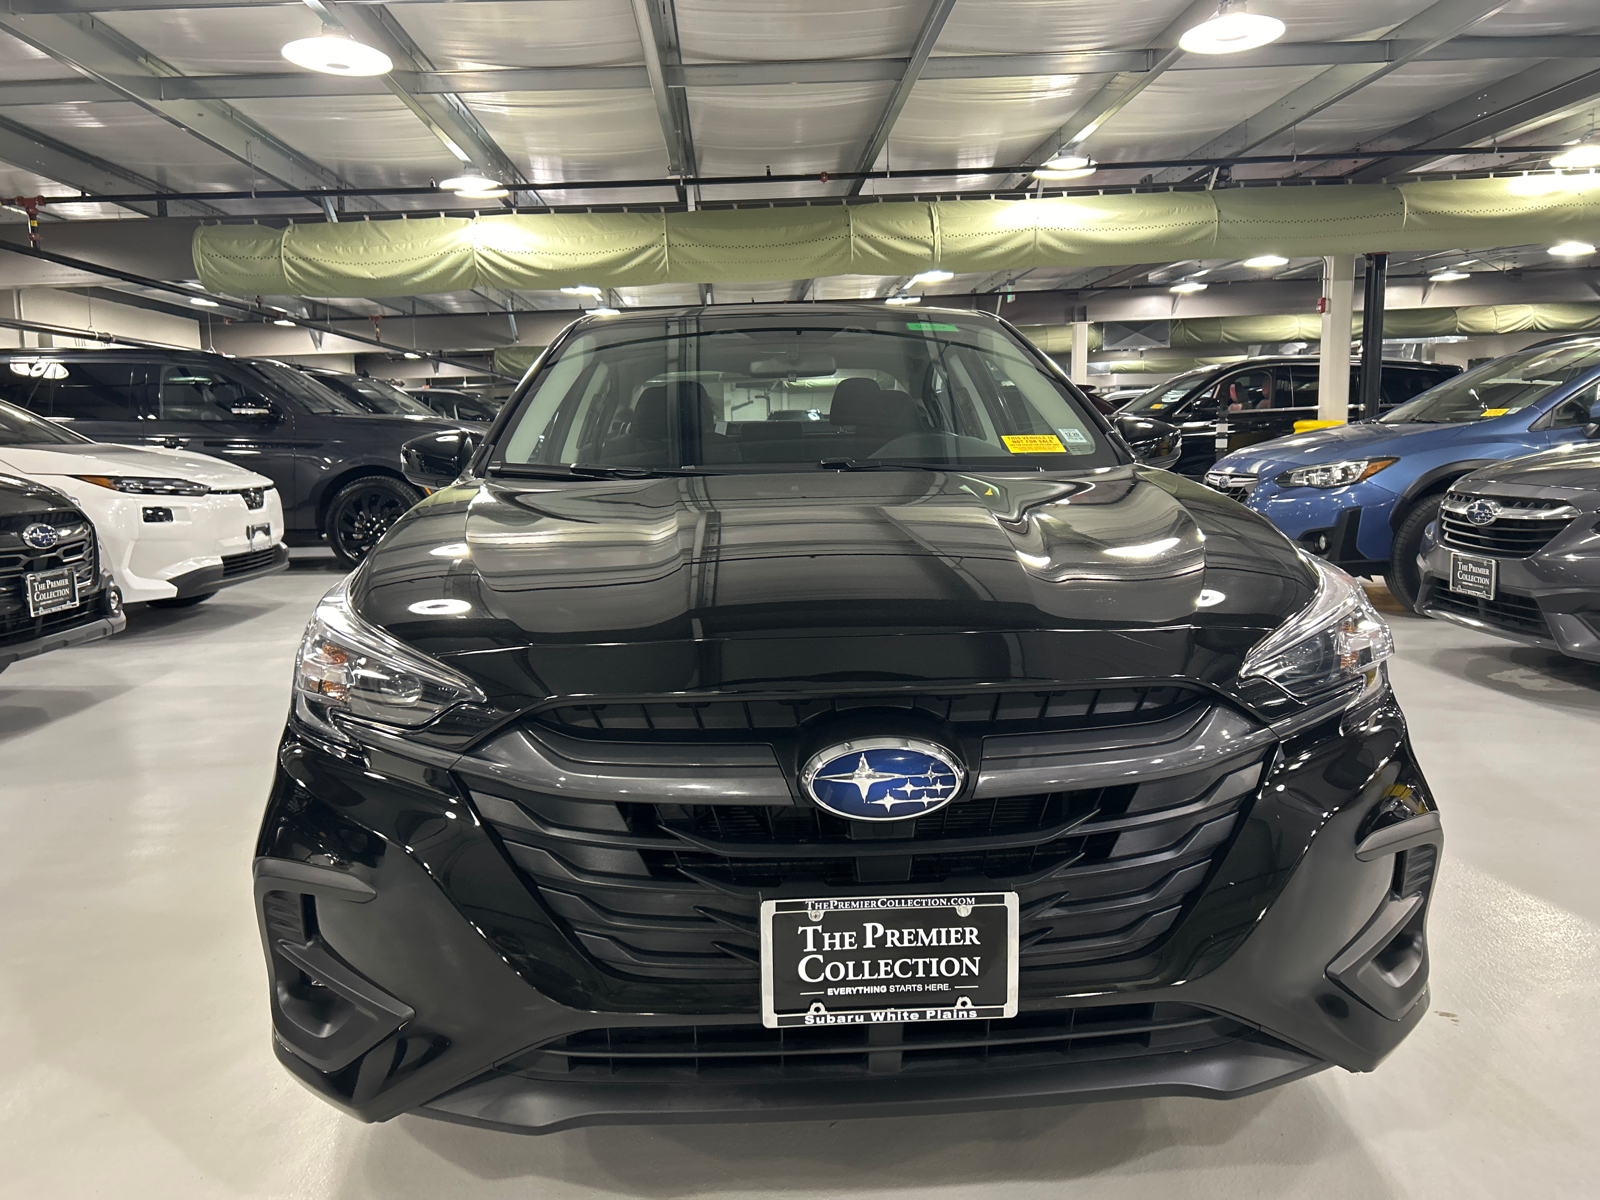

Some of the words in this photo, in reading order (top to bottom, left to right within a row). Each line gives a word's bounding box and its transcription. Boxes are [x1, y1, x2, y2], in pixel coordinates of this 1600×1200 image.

[798, 925, 858, 952] THE
[862, 922, 981, 949] PREMIER
[797, 954, 981, 983] COLLECTION
[827, 985, 887, 996] EVERYTHING
[888, 984, 923, 993] STARTS
[924, 983, 952, 991] HERE.
[804, 1013, 864, 1025] Subaru
[870, 1009, 919, 1022] White
[926, 1009, 978, 1020] Plains
